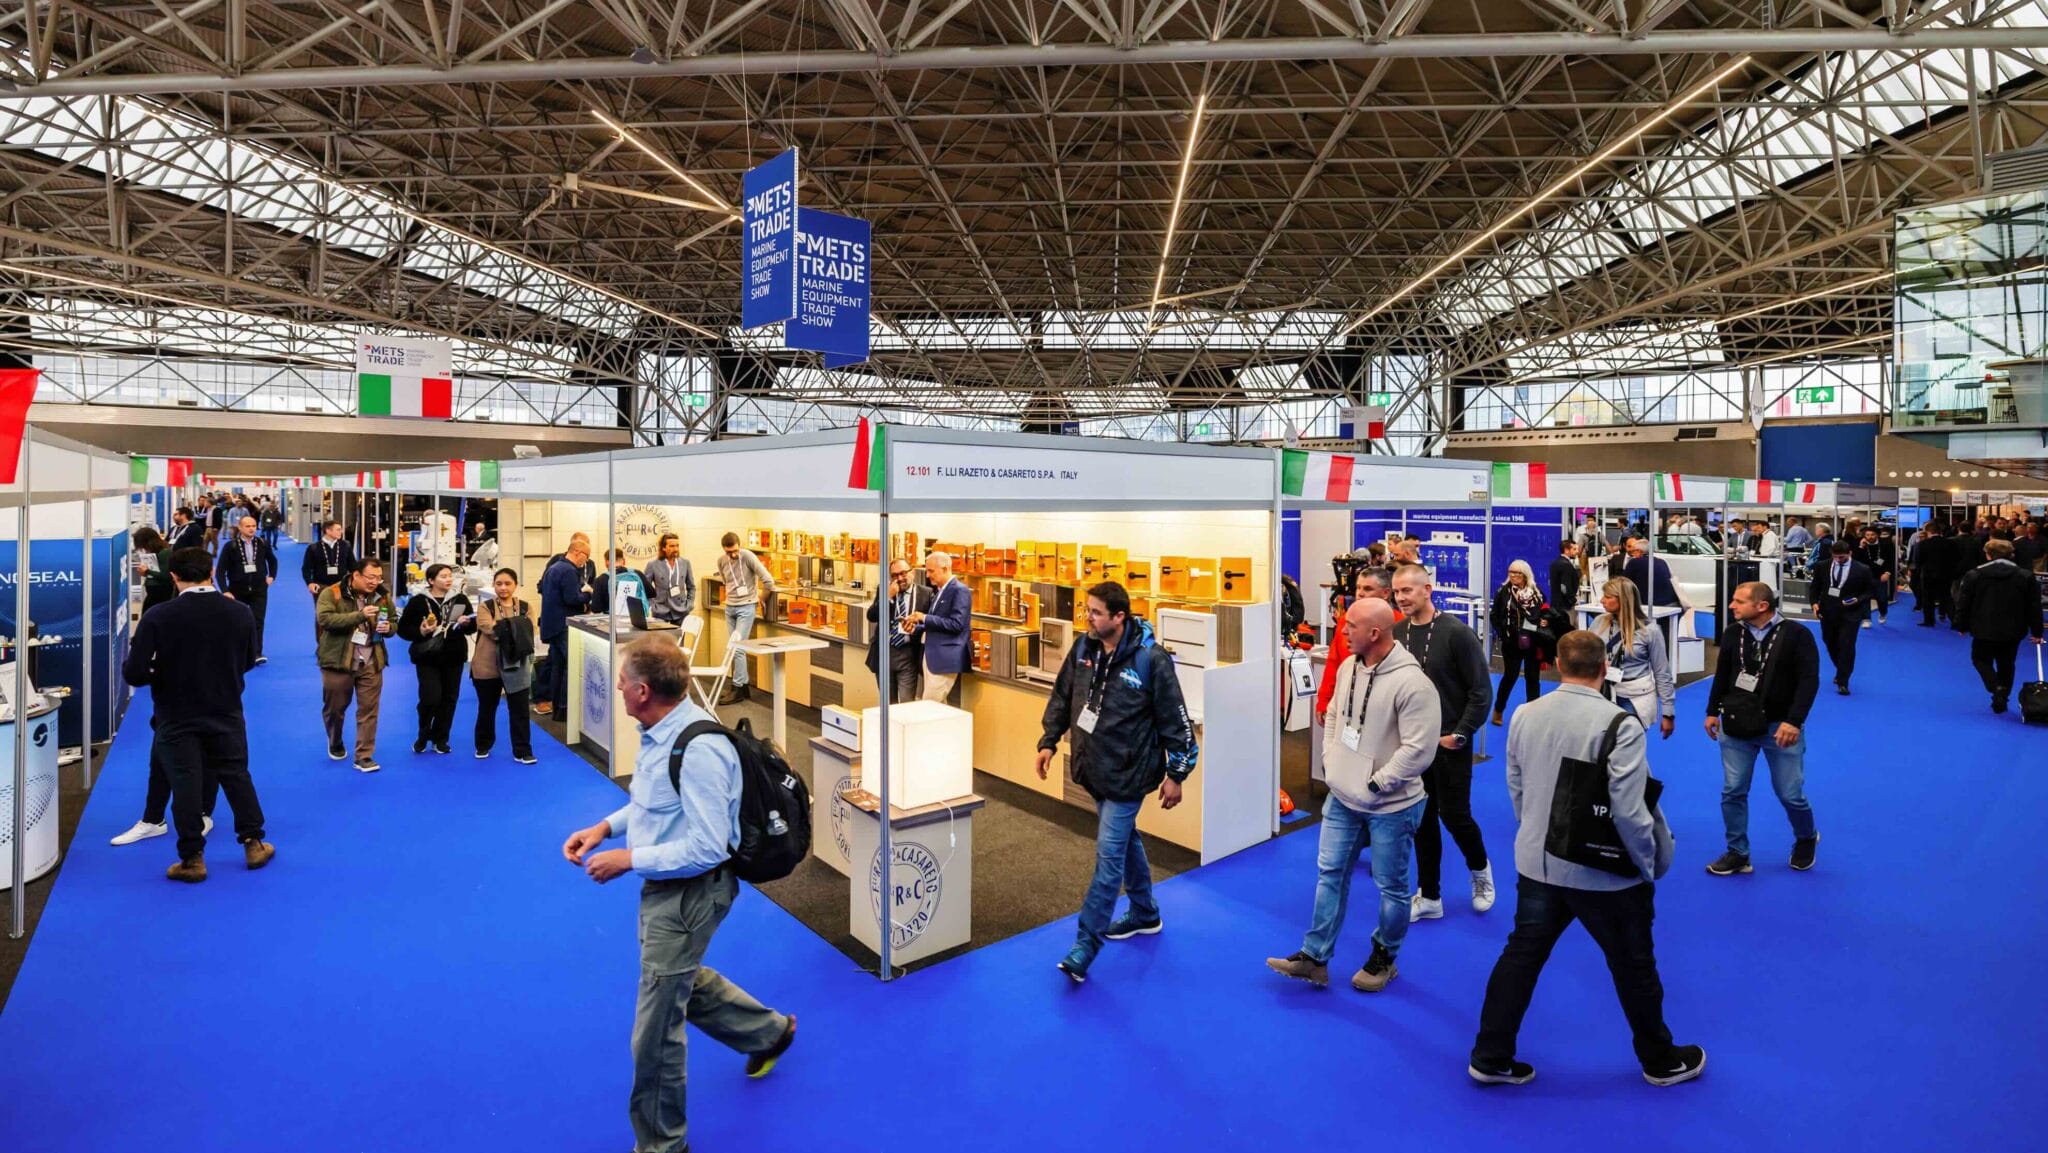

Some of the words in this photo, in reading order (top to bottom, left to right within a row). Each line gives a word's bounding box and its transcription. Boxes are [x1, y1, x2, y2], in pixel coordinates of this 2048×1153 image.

[754, 181, 790, 218] METS
[750, 207, 790, 243] TRADE
[751, 239, 777, 257] MARINE
[807, 234, 865, 263] METS
[751, 248, 789, 272] EQUIPMENT
[751, 269, 772, 286] TRADE
[799, 255, 865, 284] TRADE
[751, 284, 770, 300] SHOW
[802, 278, 843, 294] MARINE
[802, 290, 863, 308] EQUIPMENT
[802, 302, 836, 317] TRADE
[801, 314, 834, 328] SHOW
[371, 345, 404, 357] METS
[366, 354, 405, 366] TRADE
[906, 466, 931, 476] 12.101
[937, 467, 944, 476] F.
[945, 467, 957, 477] LLI
[958, 467, 989, 478] RAZETO
[990, 469, 996, 478] &
[998, 469, 1036, 479] CASARETO
[1037, 469, 1055, 479] S.P.A.
[1060, 471, 1078, 480] ITALY
[836, 833, 852, 858] SORI
